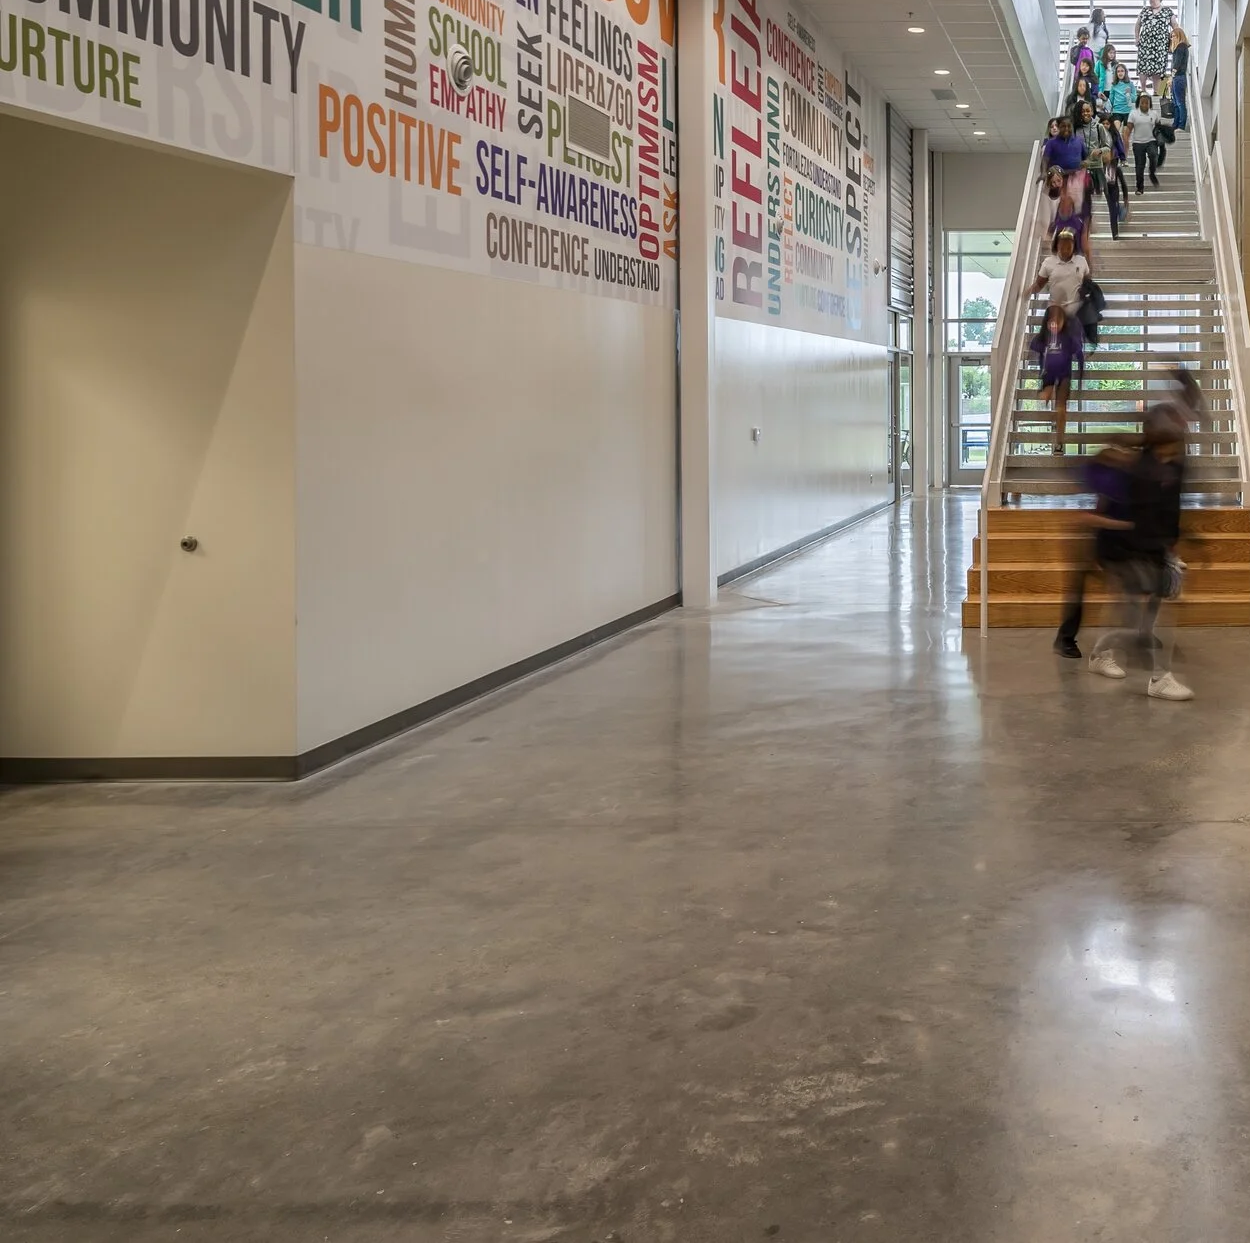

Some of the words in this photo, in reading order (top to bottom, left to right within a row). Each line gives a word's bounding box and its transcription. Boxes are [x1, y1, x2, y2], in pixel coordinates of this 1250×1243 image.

[517, 20, 543, 139] SEEK
[766, 18, 815, 97] CONFIDENCE
[319, 83, 462, 196] POSITIVE
[638, 39, 660, 261] OPTIMISM
[783, 81, 843, 170] COMMUNITY
[476, 140, 638, 240] SELF-AWARENESS
[767, 76, 780, 315] UNDERSTAND
[795, 182, 844, 251] CURIOSITY
[486, 212, 589, 277] CONFIDENCE
[594, 248, 660, 292] UNDERSTAND
